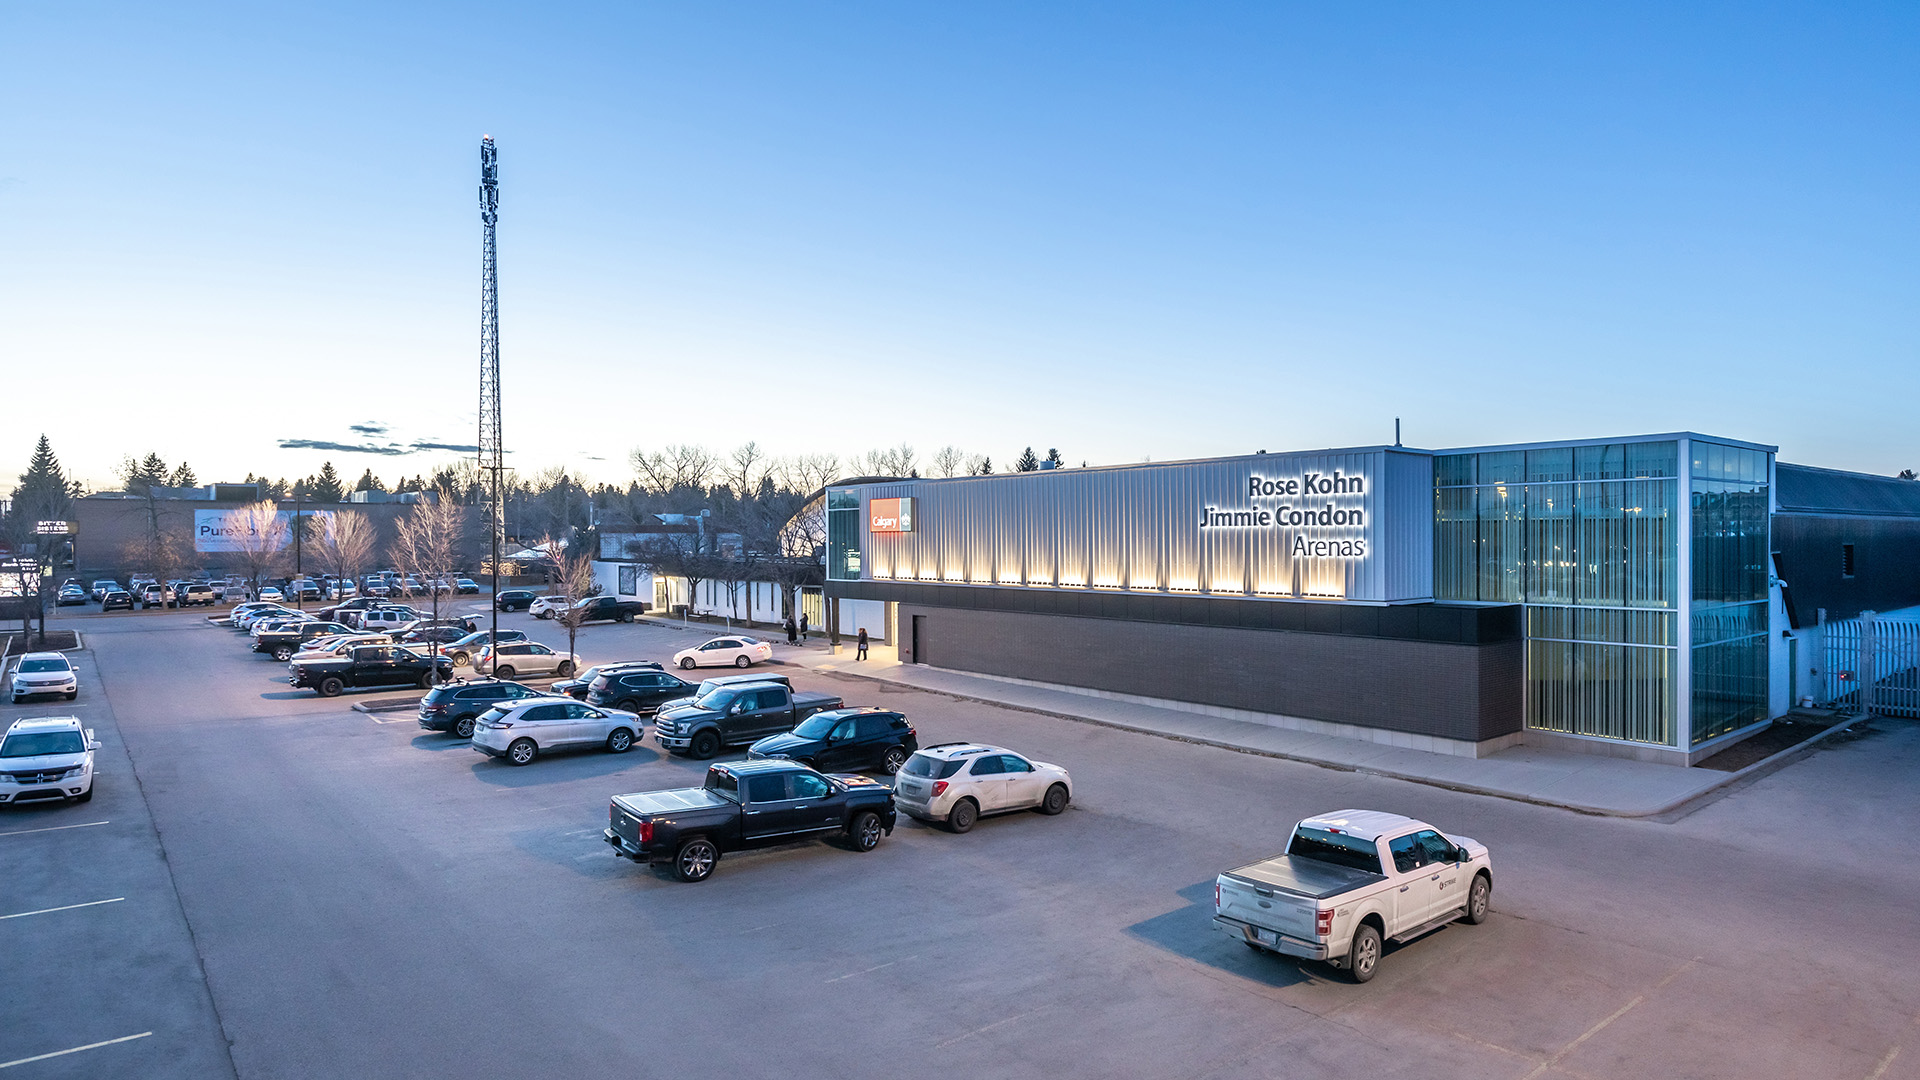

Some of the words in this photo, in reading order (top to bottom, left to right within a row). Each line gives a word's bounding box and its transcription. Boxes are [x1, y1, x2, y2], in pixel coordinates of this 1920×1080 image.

[1249, 476, 1299, 497] Rose
[1304, 471, 1364, 495] Kohn
[872, 516, 898, 528] Calgary
[1200, 506, 1271, 527] Jimmie
[1275, 504, 1363, 526] Condon
[1292, 535, 1365, 557] Arenas
